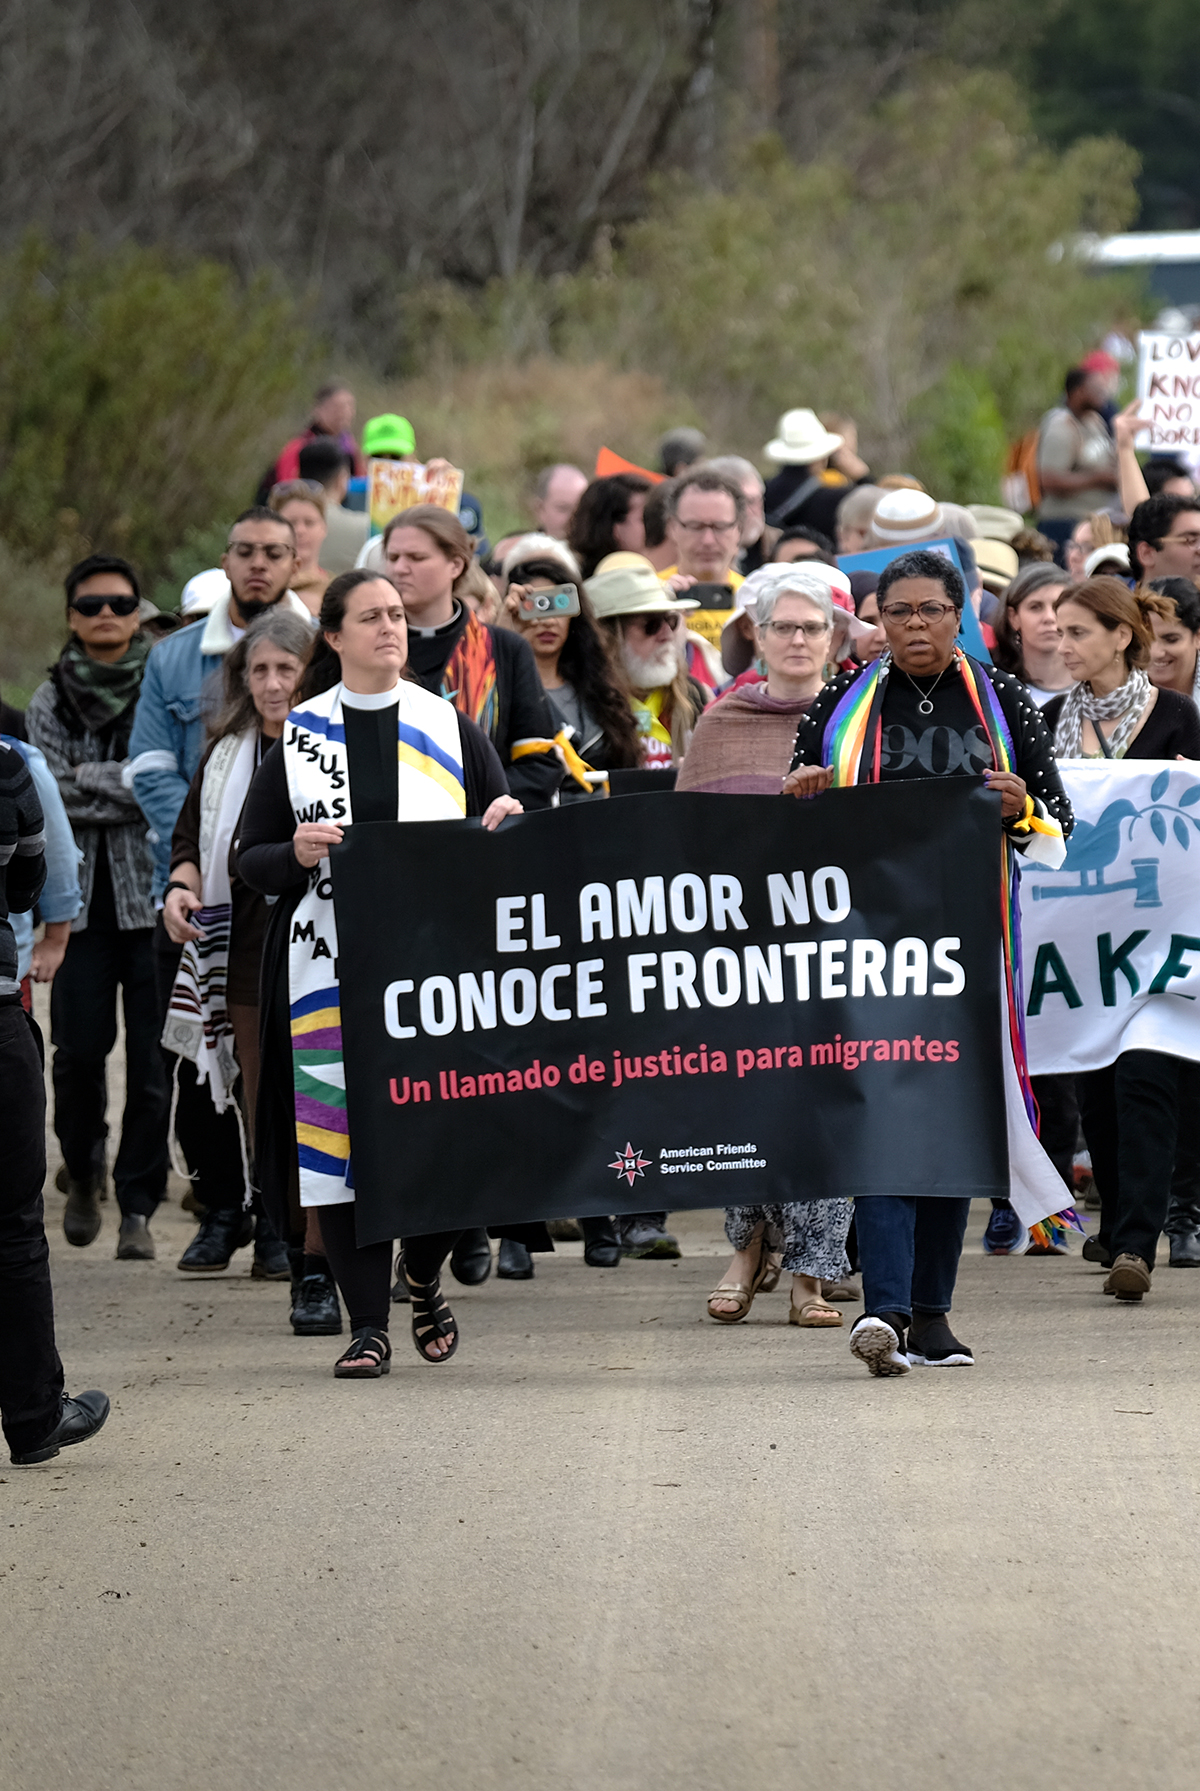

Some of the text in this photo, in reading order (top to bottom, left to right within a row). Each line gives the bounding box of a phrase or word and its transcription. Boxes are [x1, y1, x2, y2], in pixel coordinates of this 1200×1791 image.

[1153, 402, 1193, 422] NO
[296, 798, 346, 824] WAS
[495, 865, 853, 953] EL AMOR NO
[383, 936, 967, 1039] CONOCE FRONTERAS
[389, 1033, 961, 1105] Un llamado de justicia para migrantes
[659, 1142, 757, 1160] American Friends
[660, 1158, 767, 1175] Service Committee
